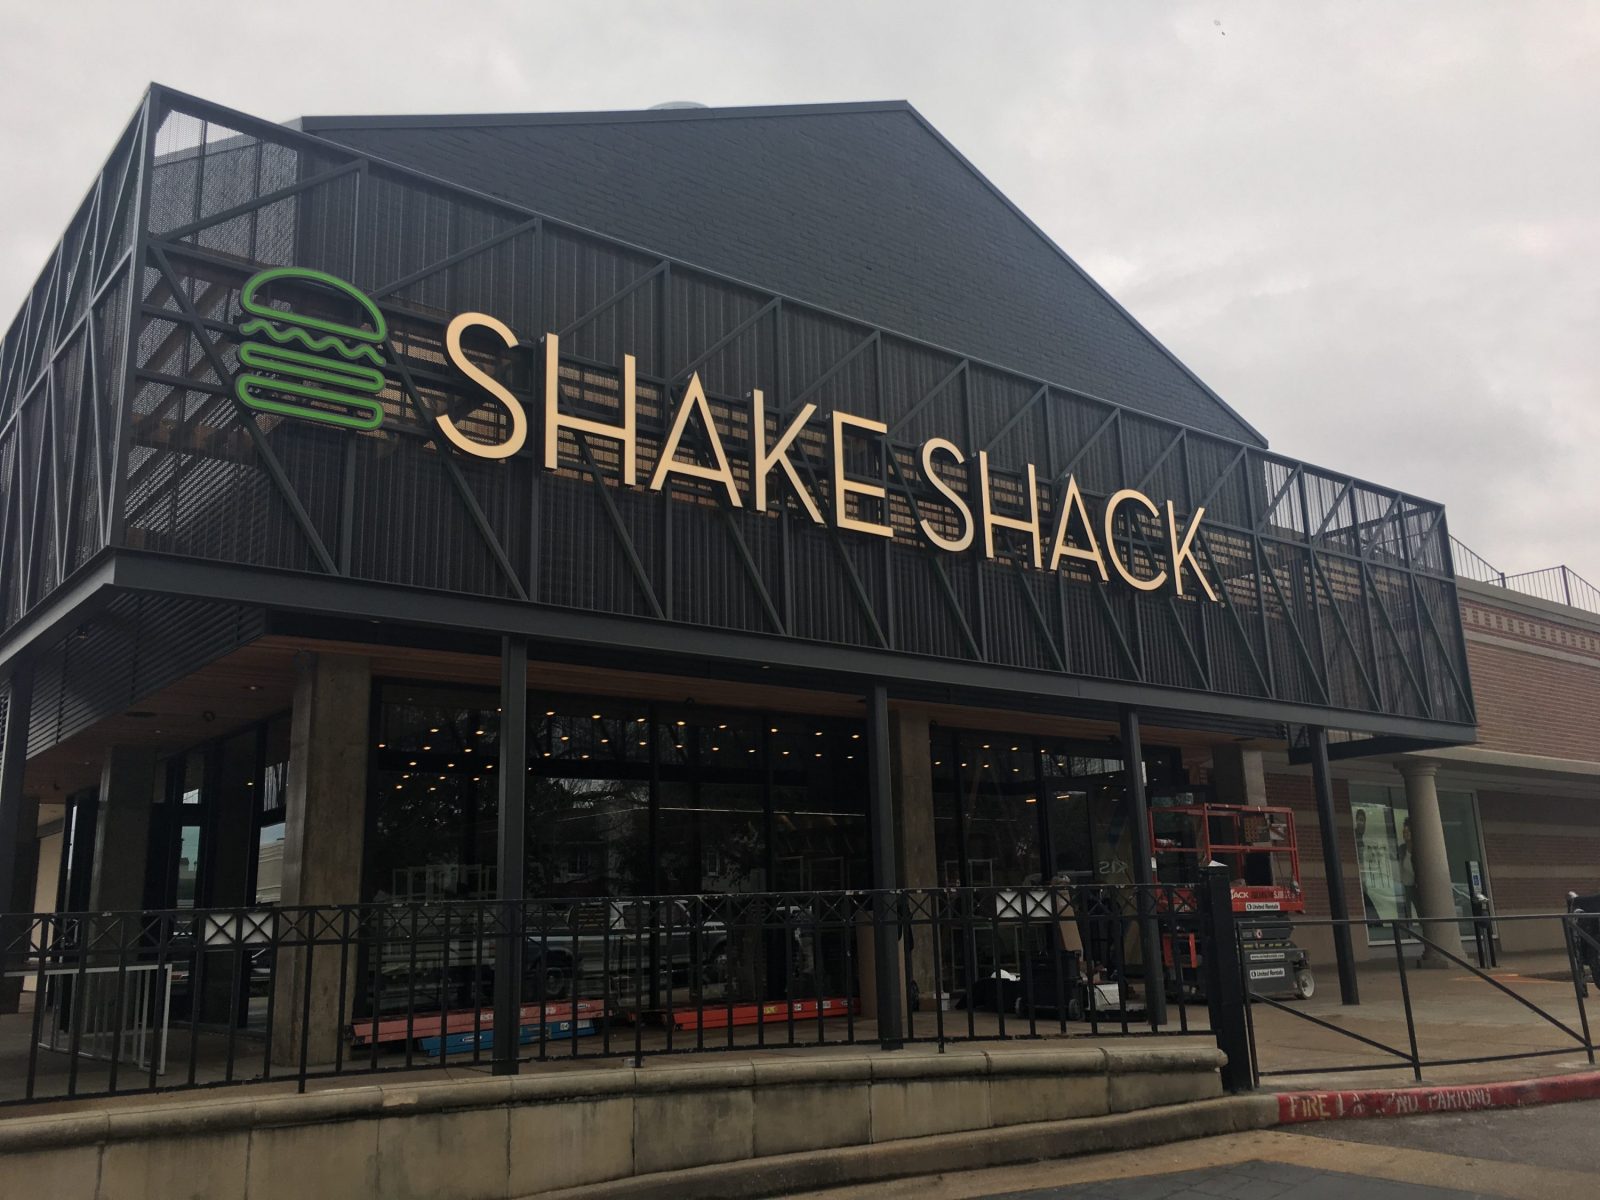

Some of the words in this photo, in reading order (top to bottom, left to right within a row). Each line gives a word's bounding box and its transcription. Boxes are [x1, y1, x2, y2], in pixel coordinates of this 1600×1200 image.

[435, 312, 895, 537] SHAKE
[919, 437, 1219, 602] SHACK
[1289, 1094, 1331, 1118] FIRE
